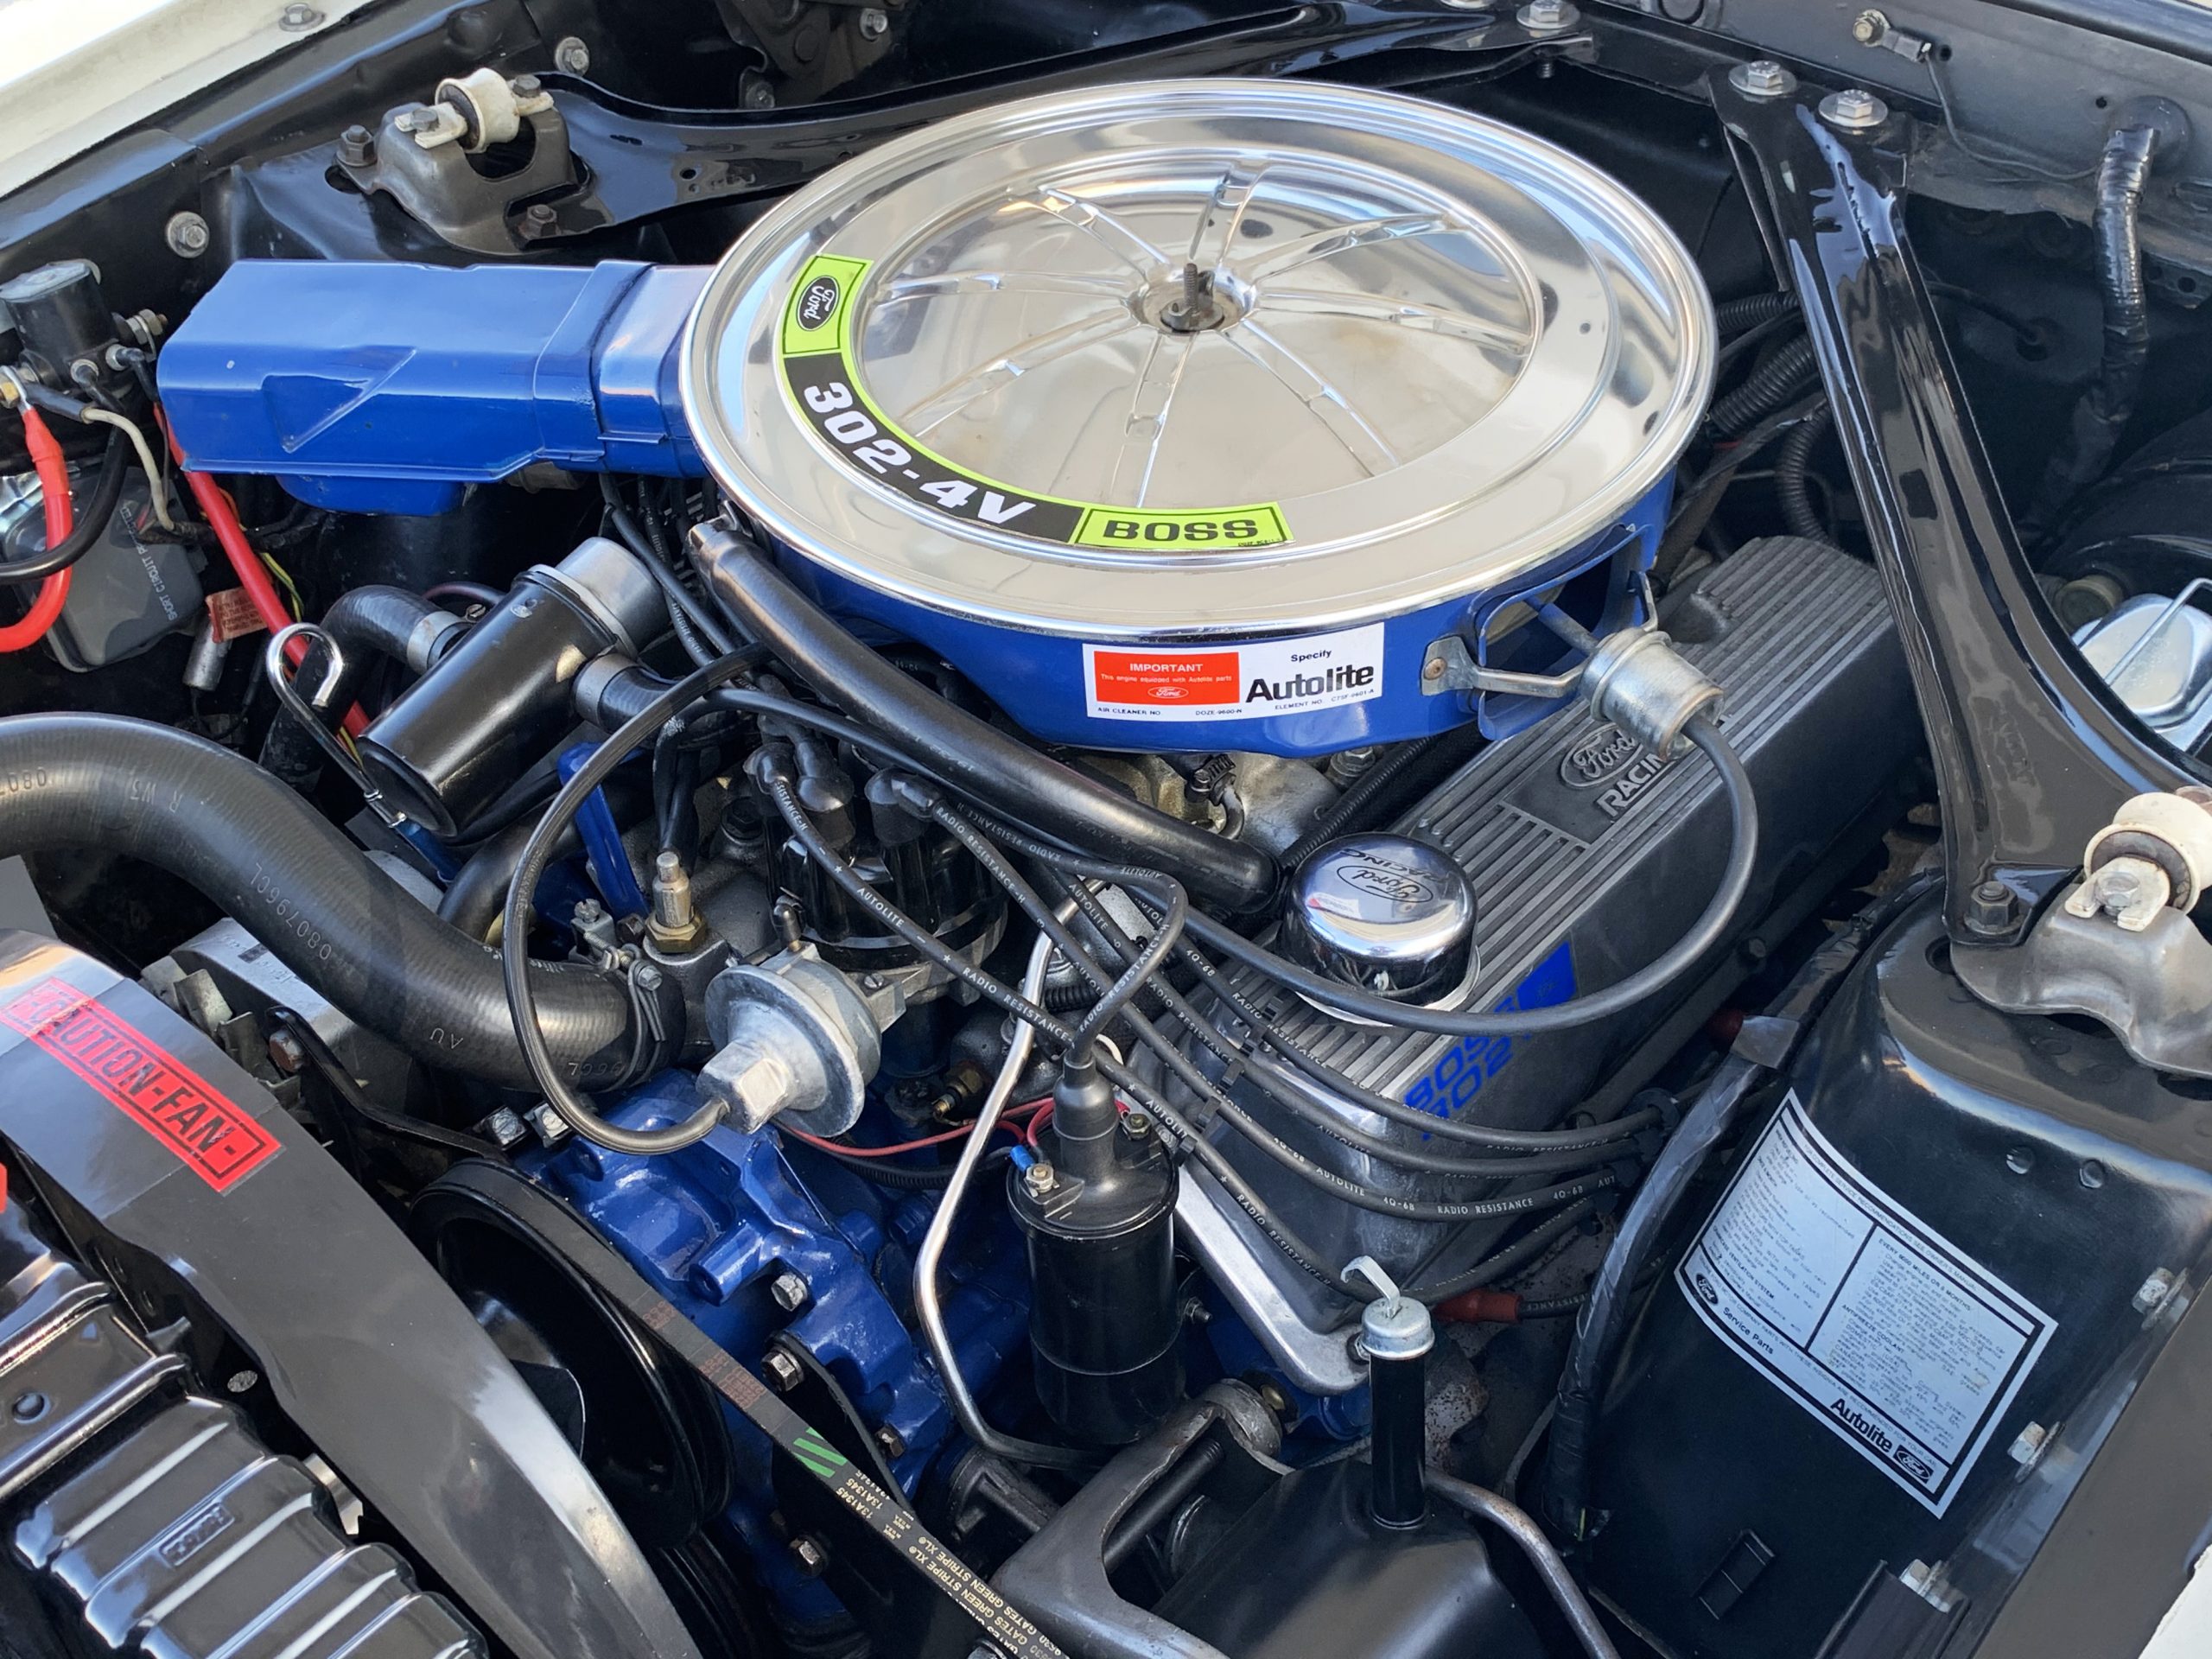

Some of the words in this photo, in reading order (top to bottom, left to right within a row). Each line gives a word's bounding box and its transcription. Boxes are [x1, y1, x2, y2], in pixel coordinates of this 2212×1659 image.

[804, 286, 835, 320] Ford
[804, 381, 1036, 524] 302-4V
[1103, 518, 1260, 542] BOSS
[142, 556, 165, 593] CIRCUIT
[158, 594, 178, 620] SHORT
[1129, 663, 1203, 672] IMPORTANT
[1291, 650, 1332, 662] Specify
[1155, 687, 1181, 697] Ford
[1245, 664, 1374, 702] Autolite
[1275, 701, 1308, 709] ELEMENT
[0, 766, 48, 797] 080
[937, 806, 964, 834] RADIO
[966, 835, 1027, 904] RESISTANCE-H
[1028, 844, 1061, 862] RADIO
[1340, 849, 1449, 883] RACING
[1351, 869, 1421, 899] Ford
[250, 862, 333, 961] 080796CL
[857, 887, 906, 928] AUTOLITE
[1068, 883, 1109, 931] AUTOLITE
[963, 967, 998, 995] RADIO
[1146, 976, 1173, 1008] RADIO
[1232, 993, 1262, 1020] RADIO
[1146, 1100, 1189, 1141] AUTOLIT
[1316, 1166, 1365, 1197] AUTOLITE
[1437, 1205, 1469, 1215] RADIO
[1475, 1198, 1535, 1215] RESISTANCE
[1236, 1194, 1266, 1226] RADIO
[1753, 1277, 1775, 1300] SYSTEM
[1878, 1238, 1897, 1255] EVERY
[1911, 1264, 1930, 1280] MILES
[1929, 1277, 1941, 1287] OR
[1944, 1288, 1972, 1311] MONTHS
[1723, 1306, 1751, 1336] Service
[1752, 1333, 1774, 1355] Parts
[1830, 1397, 1893, 1453] Autolite
[834, 1484, 875, 1519] 13A1345
[844, 1474, 885, 1510] 13A1345
[925, 1560, 963, 1592] STRIPE
[935, 1550, 973, 1582] STRIPE
[960, 1587, 995, 1618] GREEN
[969, 1578, 1005, 1609] GREEN
[993, 1615, 1029, 1646] GATES
[1001, 1605, 1038, 1636] GATES
